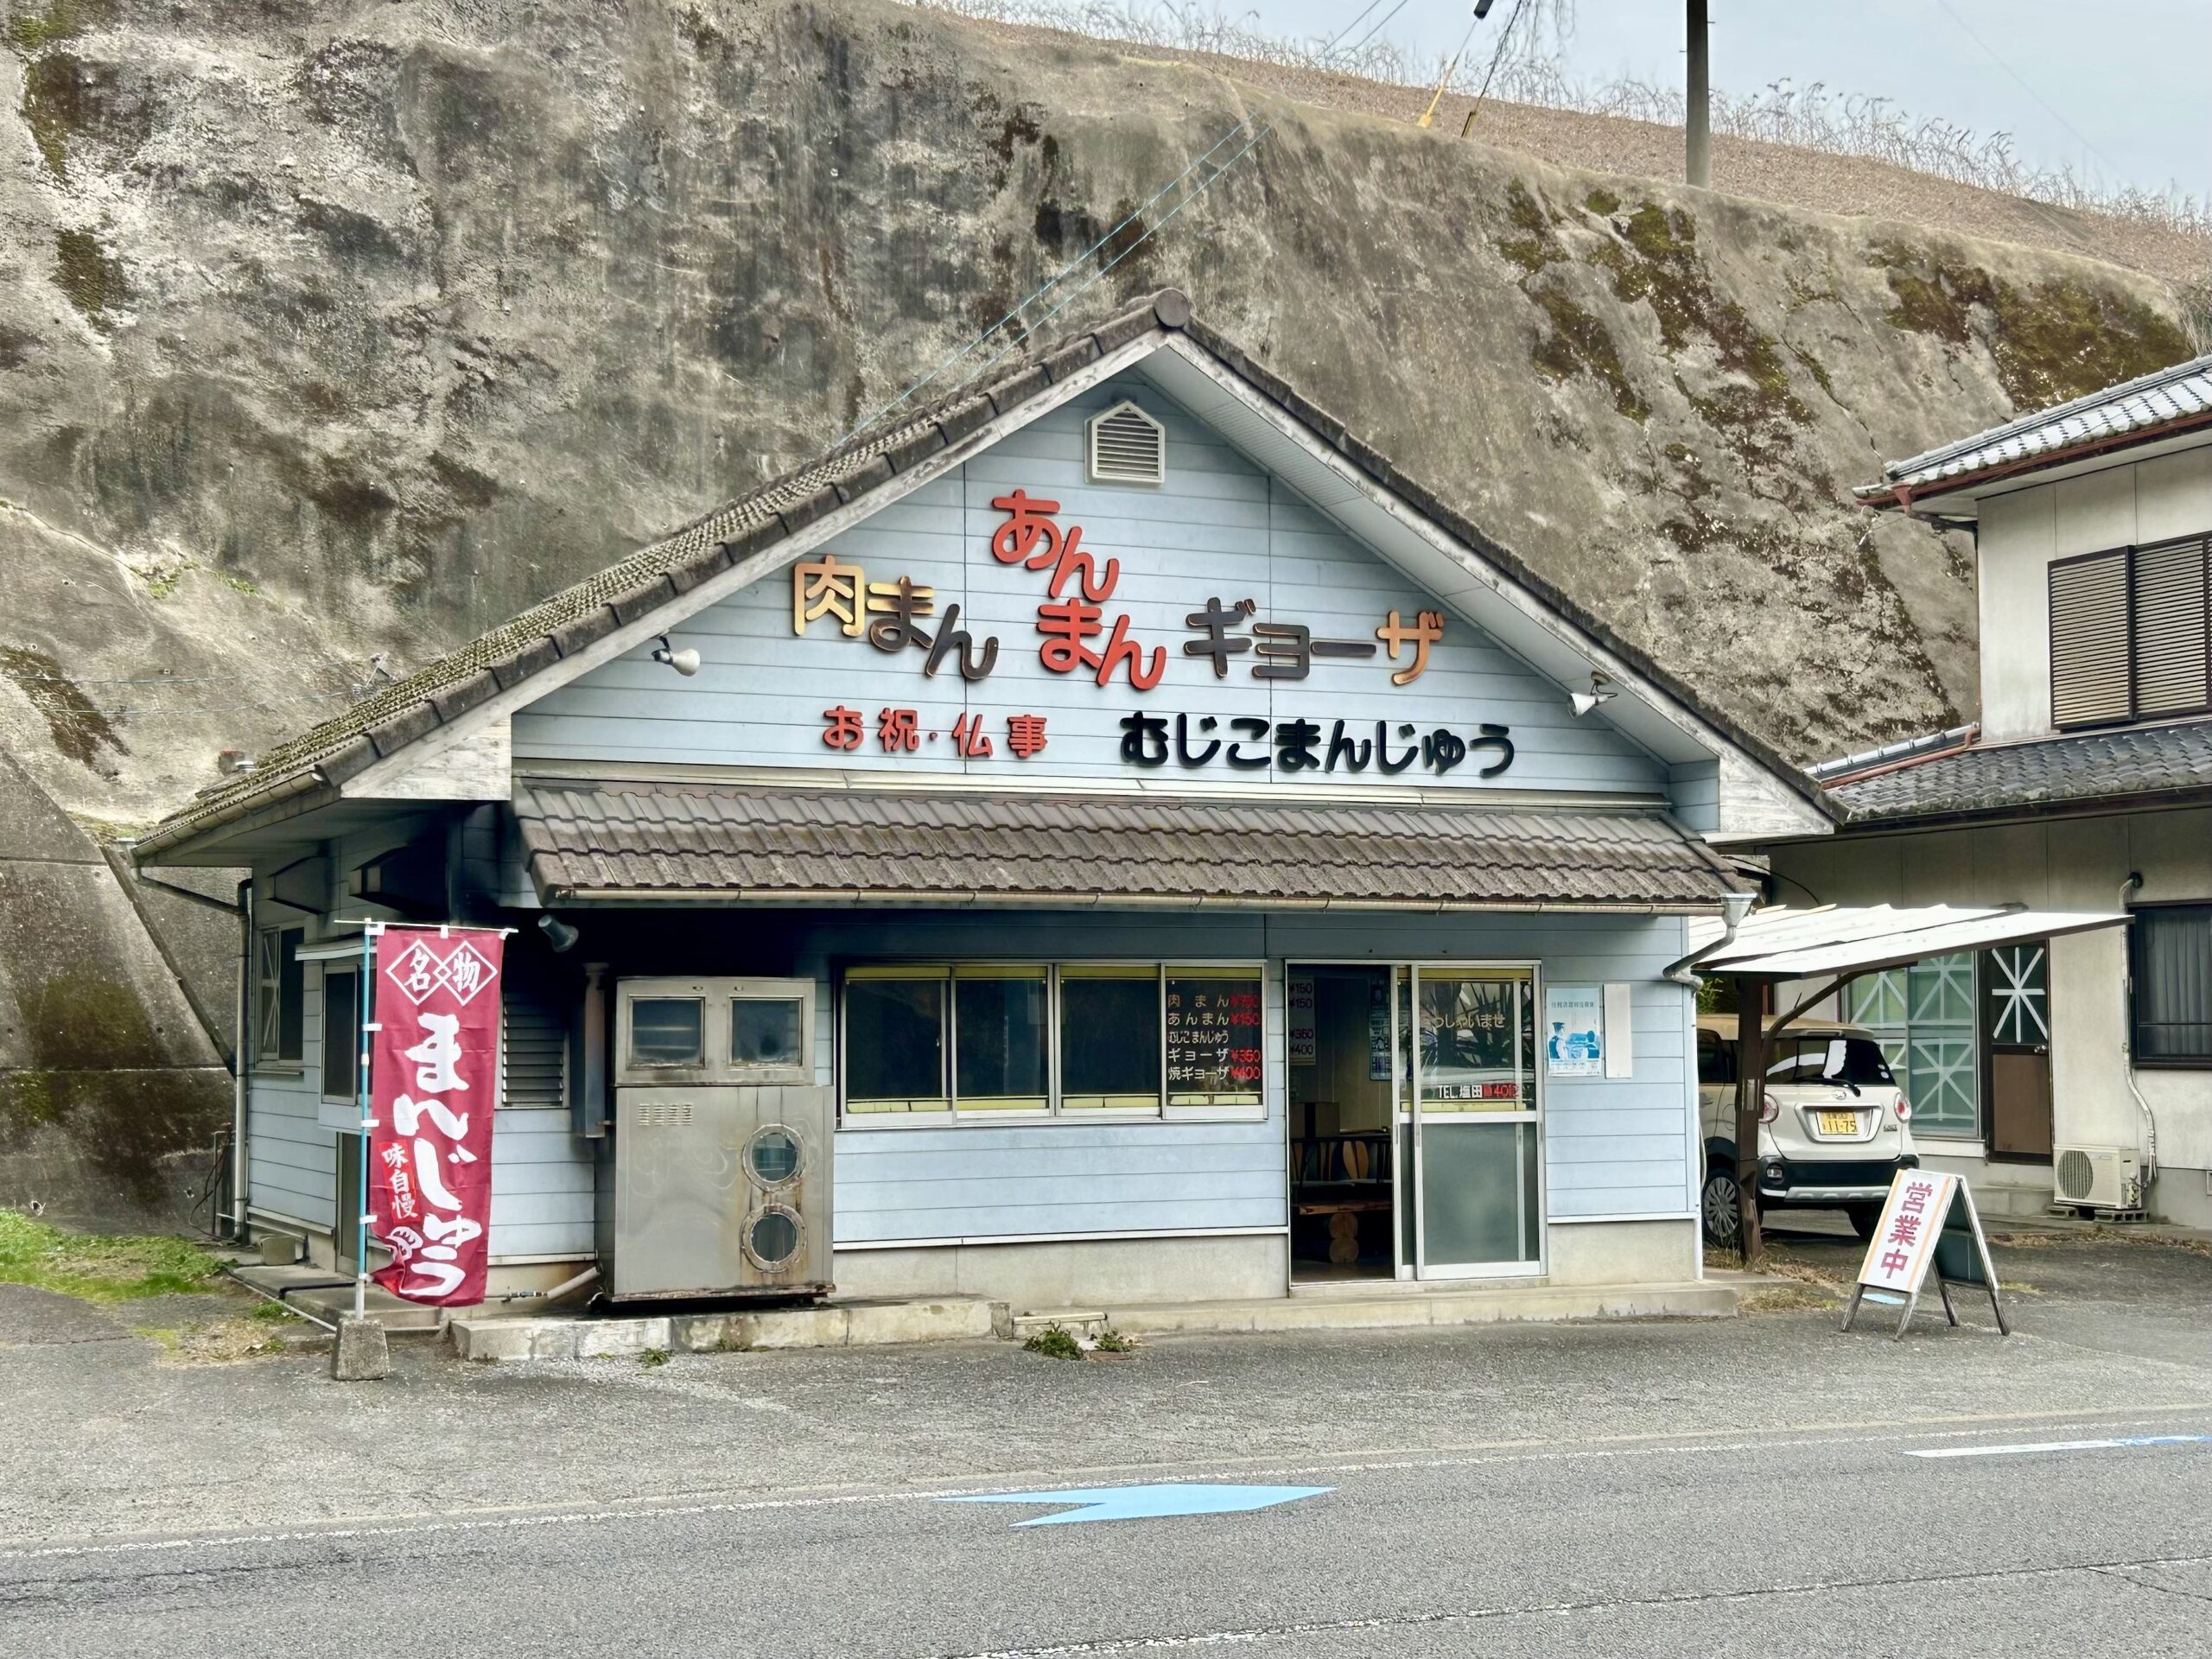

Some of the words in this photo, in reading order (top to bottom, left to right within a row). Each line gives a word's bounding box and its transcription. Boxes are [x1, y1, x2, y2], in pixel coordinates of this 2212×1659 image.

[792, 554, 1000, 680] 肉まん
[1183, 596, 1446, 684] ギョーザ
[1120, 710, 1516, 778] むじこまんじゅう
[404, 948, 481, 994] 名物
[1168, 1047, 1230, 1063] ギョーザ
[381, 1141, 418, 1221] 味自慢
[392, 1012, 484, 1297] まんじゅう
[1880, 1181, 1934, 1279] 営業中
